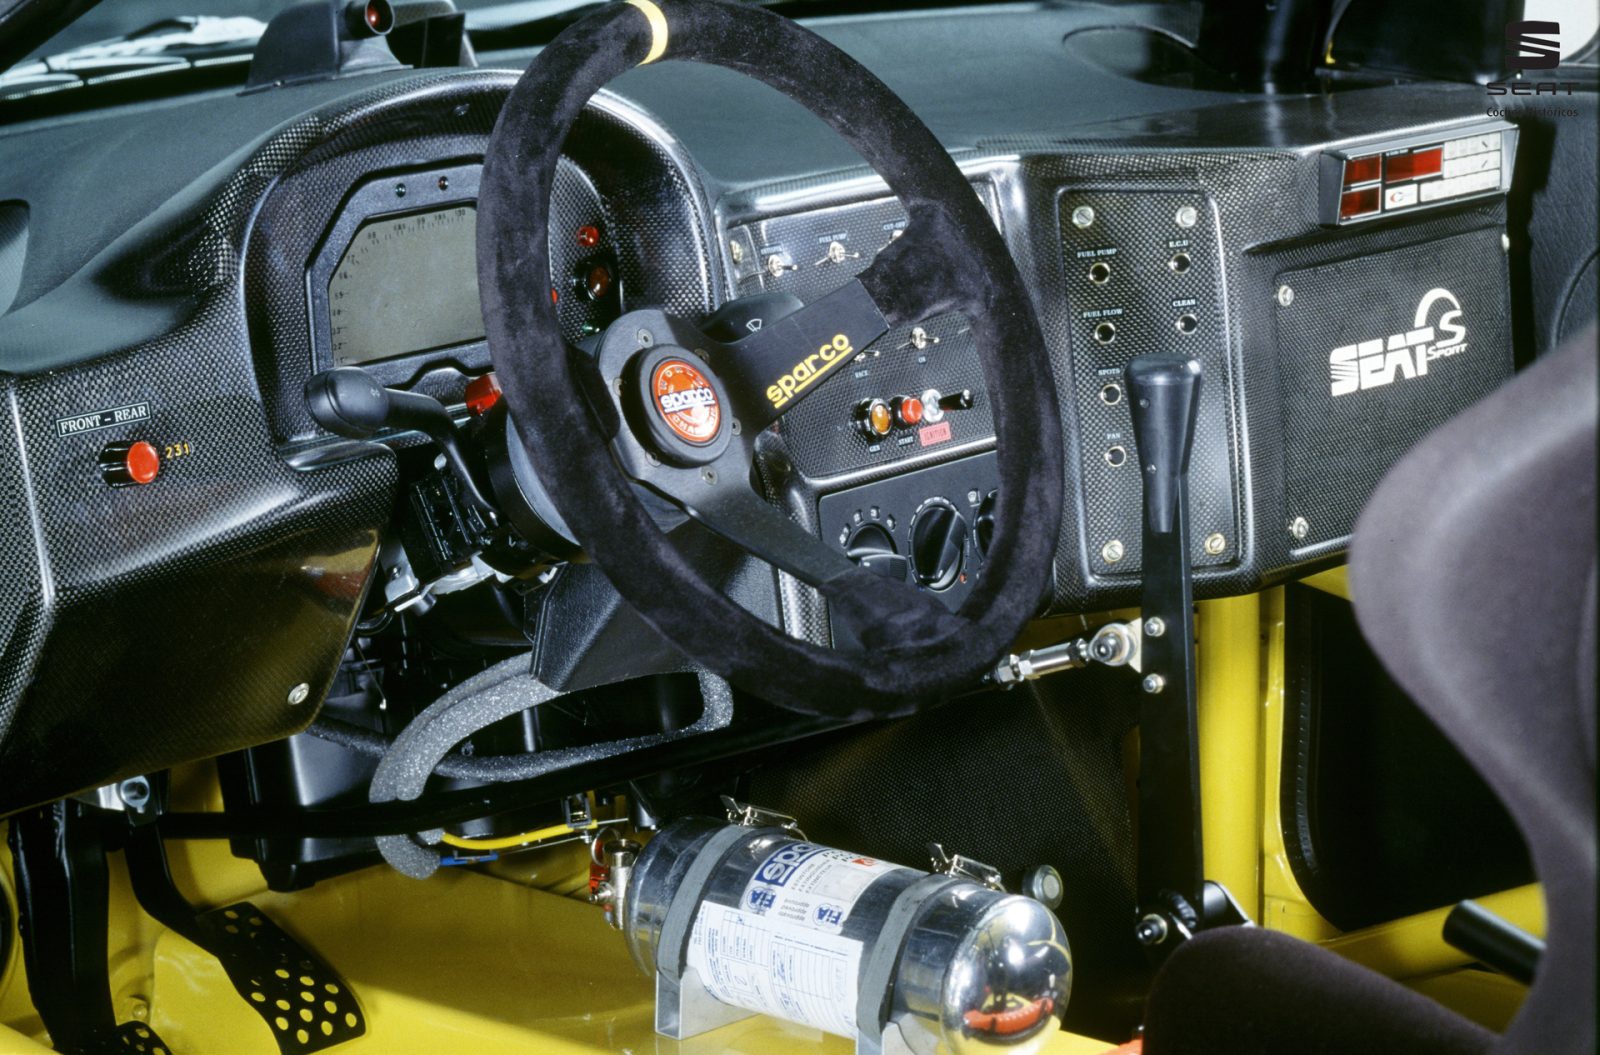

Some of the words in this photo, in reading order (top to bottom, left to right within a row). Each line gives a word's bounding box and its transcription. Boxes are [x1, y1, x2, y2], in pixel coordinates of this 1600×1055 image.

[1077, 250, 1097, 258] FUEL
[1097, 247, 1117, 256] PUMP
[1172, 298, 1196, 307] CLEAN
[1083, 310, 1102, 318] FUEL
[1102, 308, 1123, 317] FLOW
[1329, 326, 1435, 397] SEAT
[766, 334, 853, 409] sparco
[1098, 368, 1121, 376] SPOTS
[60, 414, 101, 434] FRONT
[114, 405, 147, 422] REAR
[1106, 432, 1121, 440] FAN
